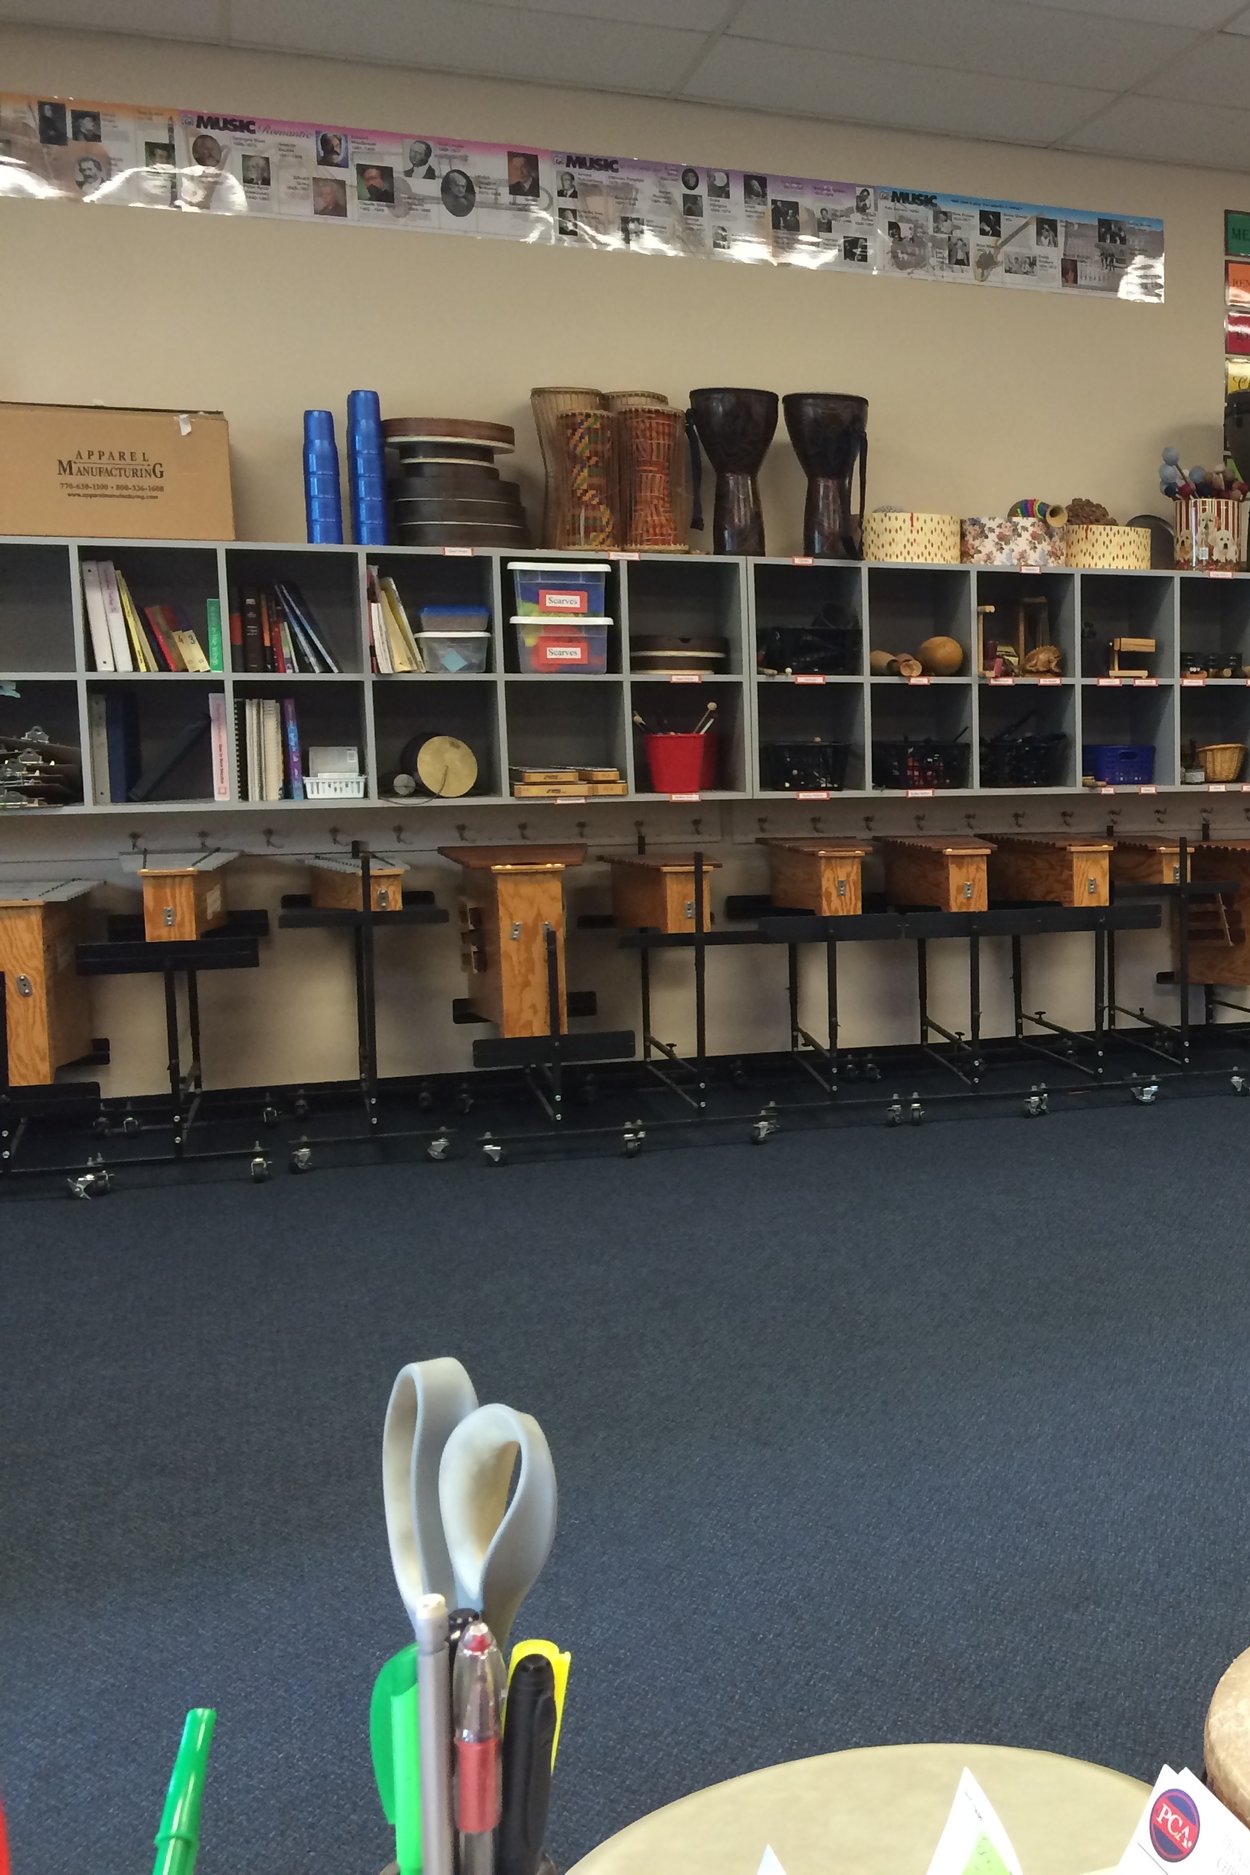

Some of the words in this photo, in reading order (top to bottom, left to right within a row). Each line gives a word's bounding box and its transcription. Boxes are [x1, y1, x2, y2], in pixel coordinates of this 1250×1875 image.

[196, 115, 256, 134] MUSIC
[566, 155, 619, 173] MUSIC
[891, 191, 938, 207] MUSIC
[75, 449, 149, 462] APPAREL
[57, 459, 164, 479] MANUFACTURING
[548, 596, 578, 605] Scarves
[548, 648, 578, 657] Scarves
[1156, 1803, 1191, 1848] PCA
